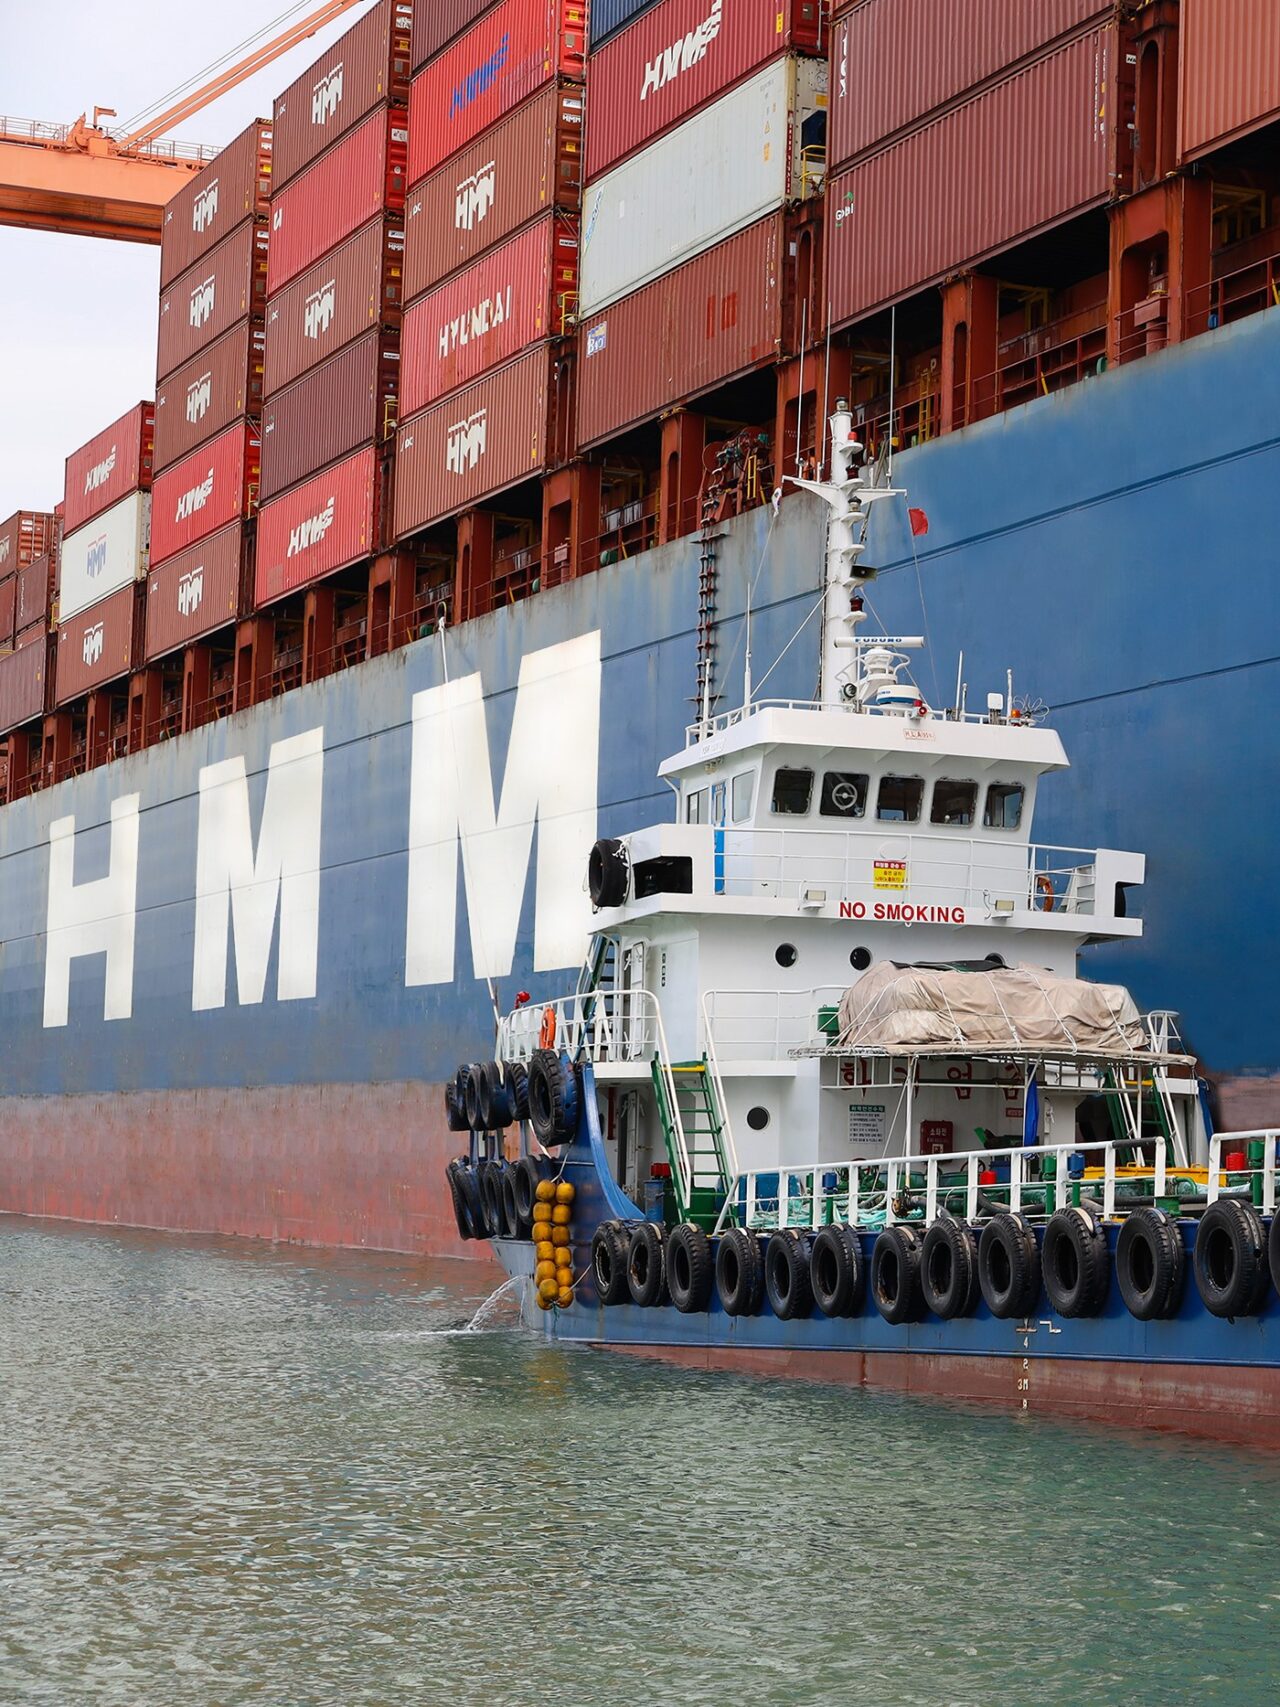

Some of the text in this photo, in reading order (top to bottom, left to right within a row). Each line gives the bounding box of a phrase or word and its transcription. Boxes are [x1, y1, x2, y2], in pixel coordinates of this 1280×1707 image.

[438, 285, 511, 360] HYUNDAI
[43, 629, 601, 1028] HMM
[839, 901, 965, 923] NO SMOKING
